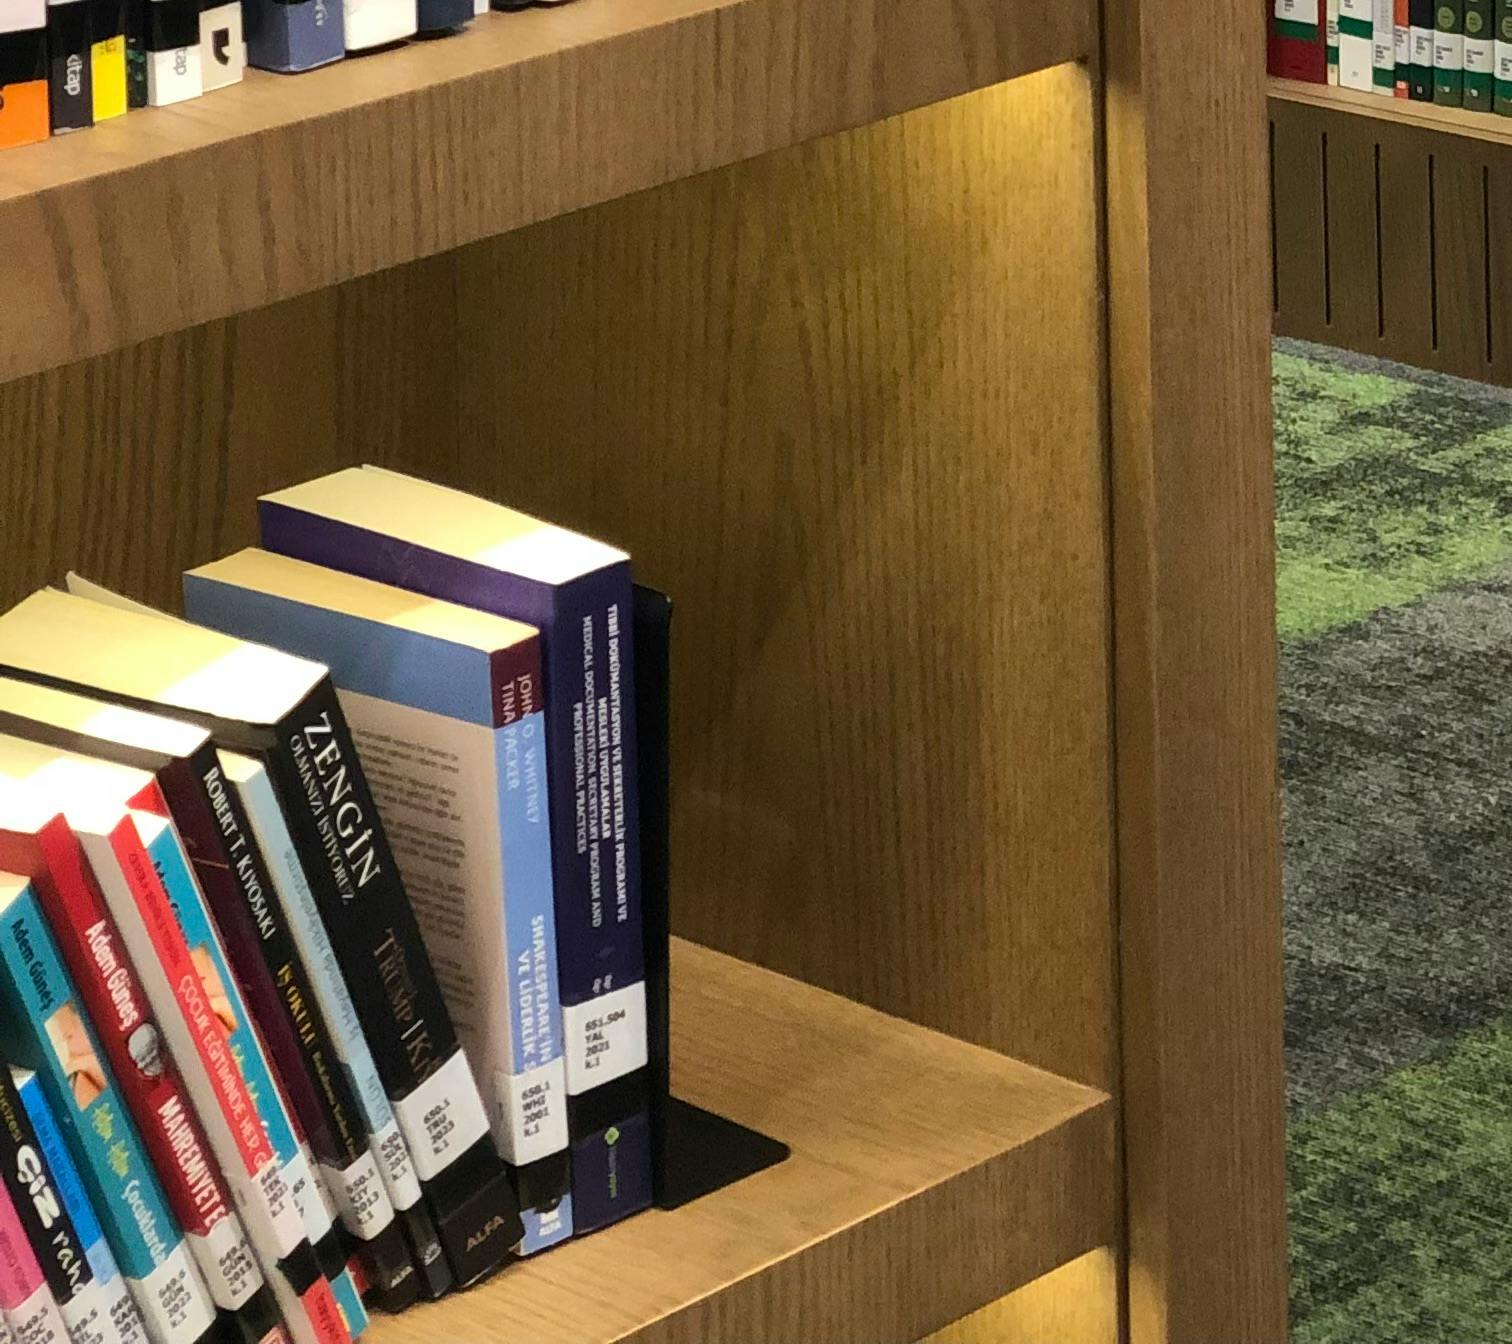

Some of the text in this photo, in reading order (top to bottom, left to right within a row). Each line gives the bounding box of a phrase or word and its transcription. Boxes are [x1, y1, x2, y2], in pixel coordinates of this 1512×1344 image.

[500, 681, 519, 791] TINA PACKER
[303, 711, 382, 889] ZENGİN
[523, 745, 540, 824] WHITNEY
[202, 766, 278, 942] ROBERT KIYOSAKI
[85, 919, 117, 970] Adem
[465, 1215, 506, 1253] ALFA
